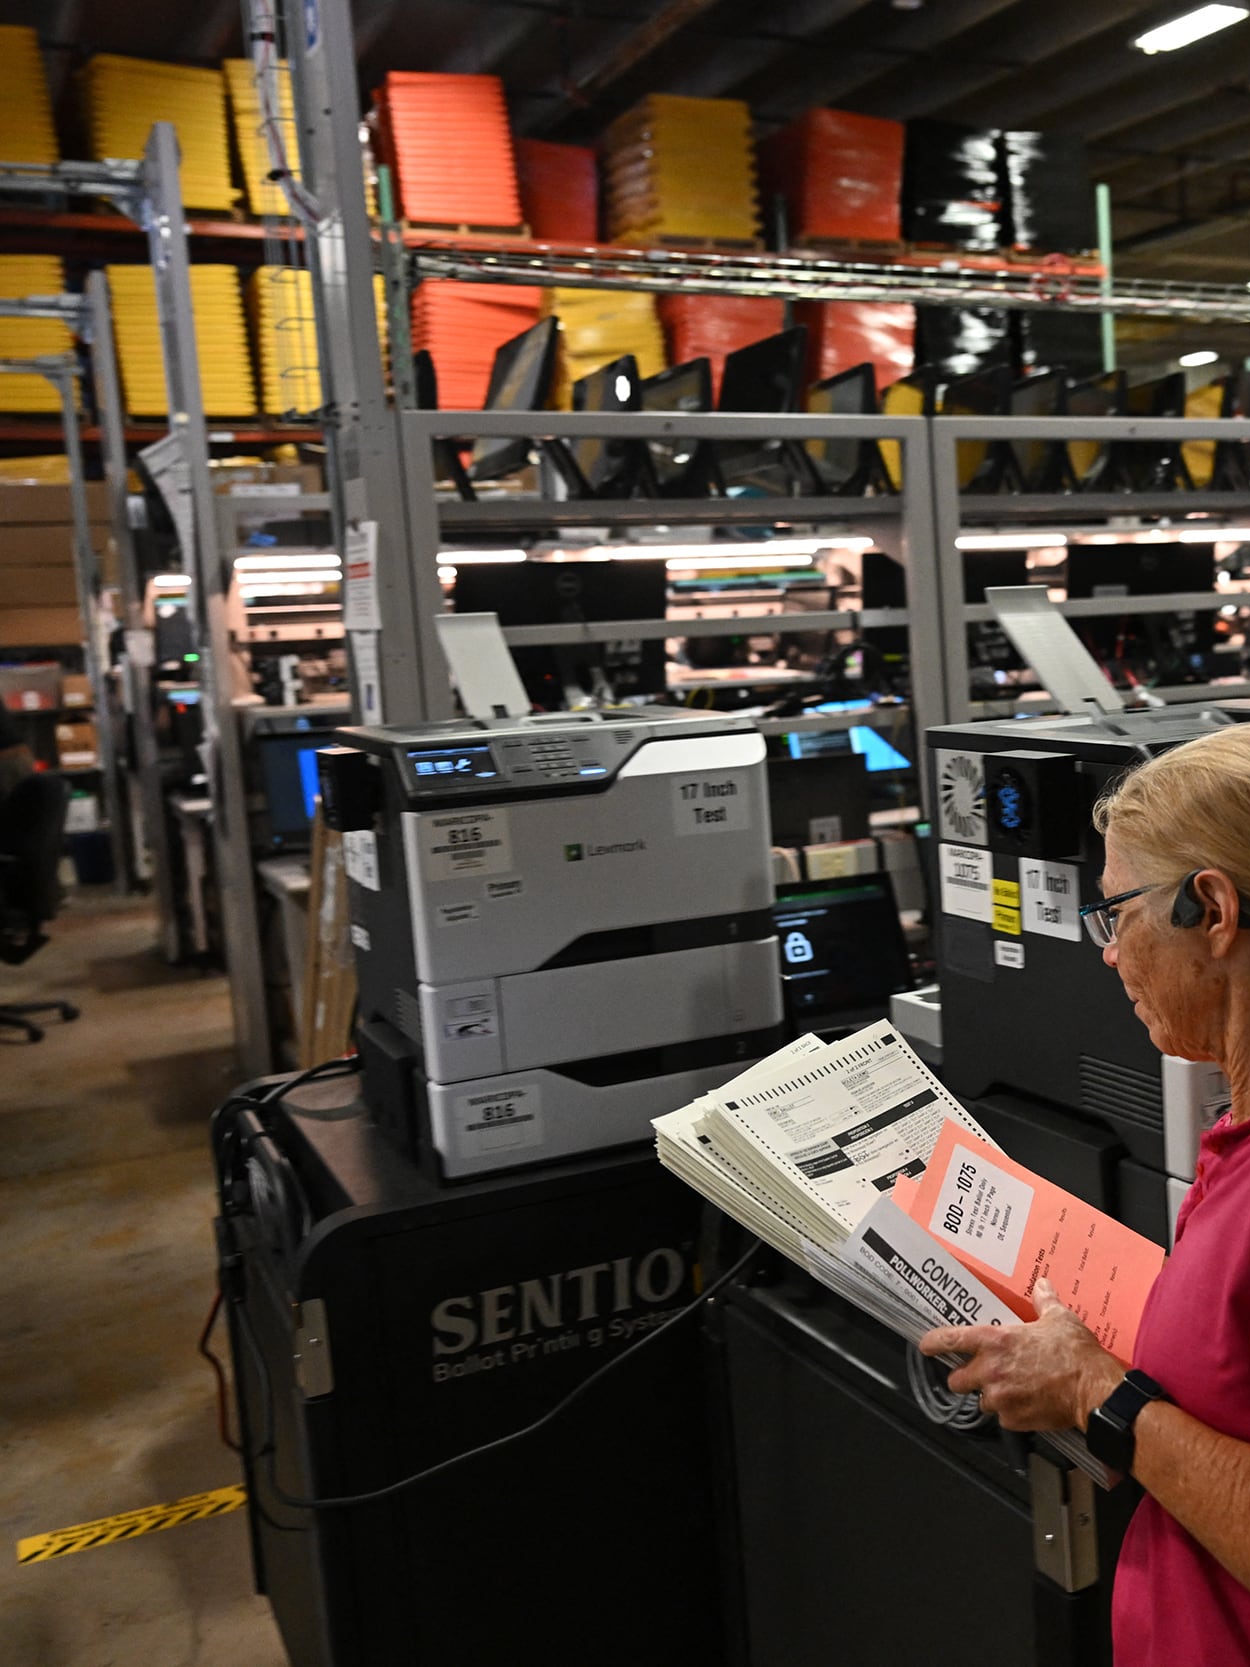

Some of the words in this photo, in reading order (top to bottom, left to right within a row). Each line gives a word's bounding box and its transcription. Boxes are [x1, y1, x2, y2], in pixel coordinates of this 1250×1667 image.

[680, 783, 699, 800] 17
[703, 779, 738, 798] Inch
[692, 806, 727, 824] Test
[448, 827, 482, 844] 816
[588, 839, 647, 857] Lexmark
[483, 1103, 516, 1121] 816
[978, 1178, 988, 1190] Only
[987, 1186, 997, 1199] Page
[943, 1204, 964, 1234] BOD
[956, 1162, 977, 1193] 1075
[974, 1190, 984, 1206] Ballot
[971, 1205, 979, 1217] Test
[990, 1206, 1000, 1226] Normal
[1000, 1203, 1012, 1232] Sequential
[965, 1218, 975, 1236] Stress
[859, 1246, 874, 1262] BOD
[1024, 1262, 1040, 1298] Tabulation
[1035, 1248, 1046, 1264] Tests
[889, 1254, 948, 1314] POLLWORKER:
[921, 1257, 983, 1322] CONTROL
[430, 1248, 685, 1356] SENTIO
[433, 1350, 507, 1383] Ballot
